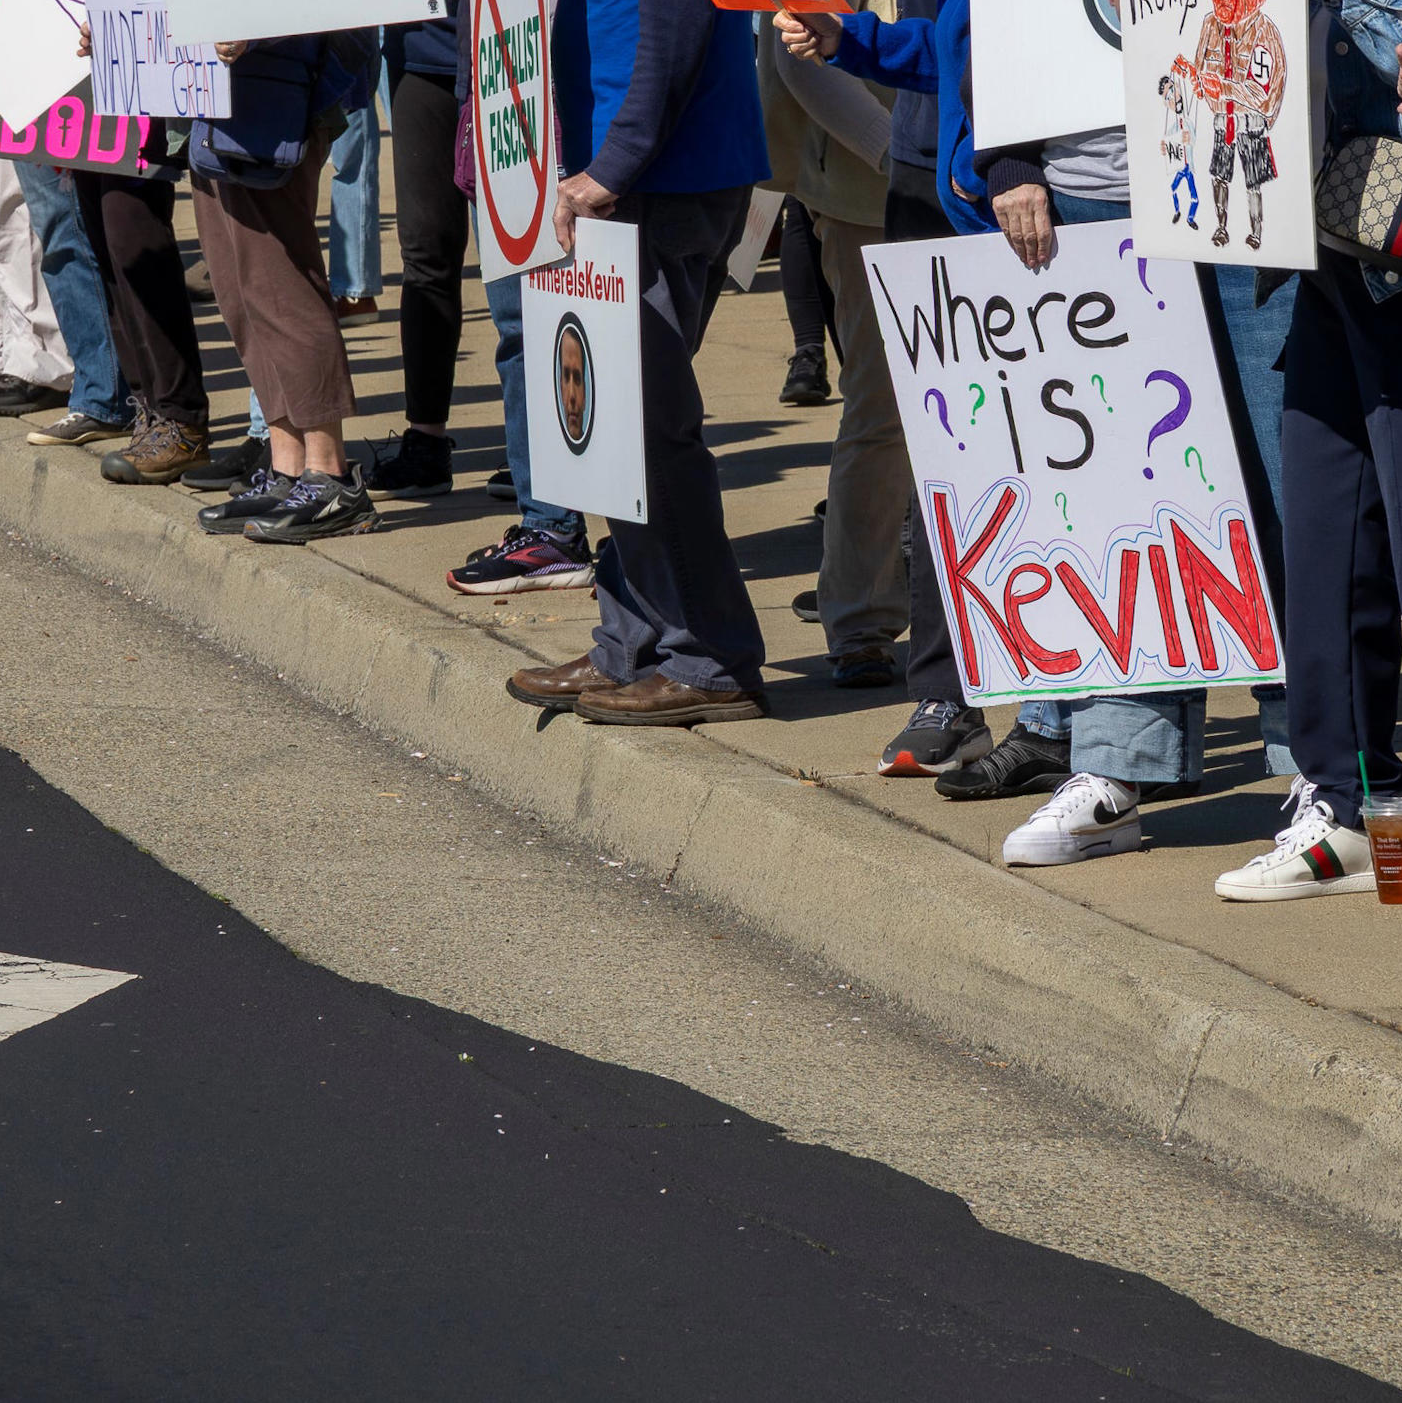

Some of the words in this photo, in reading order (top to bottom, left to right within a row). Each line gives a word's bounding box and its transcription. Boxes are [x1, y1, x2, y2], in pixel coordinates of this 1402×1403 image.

[88, 10, 150, 115] MADE
[171, 60, 218, 118] GREAT
[478, 14, 540, 101] CAPITALIST
[488, 96, 538, 175] FASCISM
[528, 258, 625, 304] #WhereIsKevin
[872, 256, 1130, 374] Where
